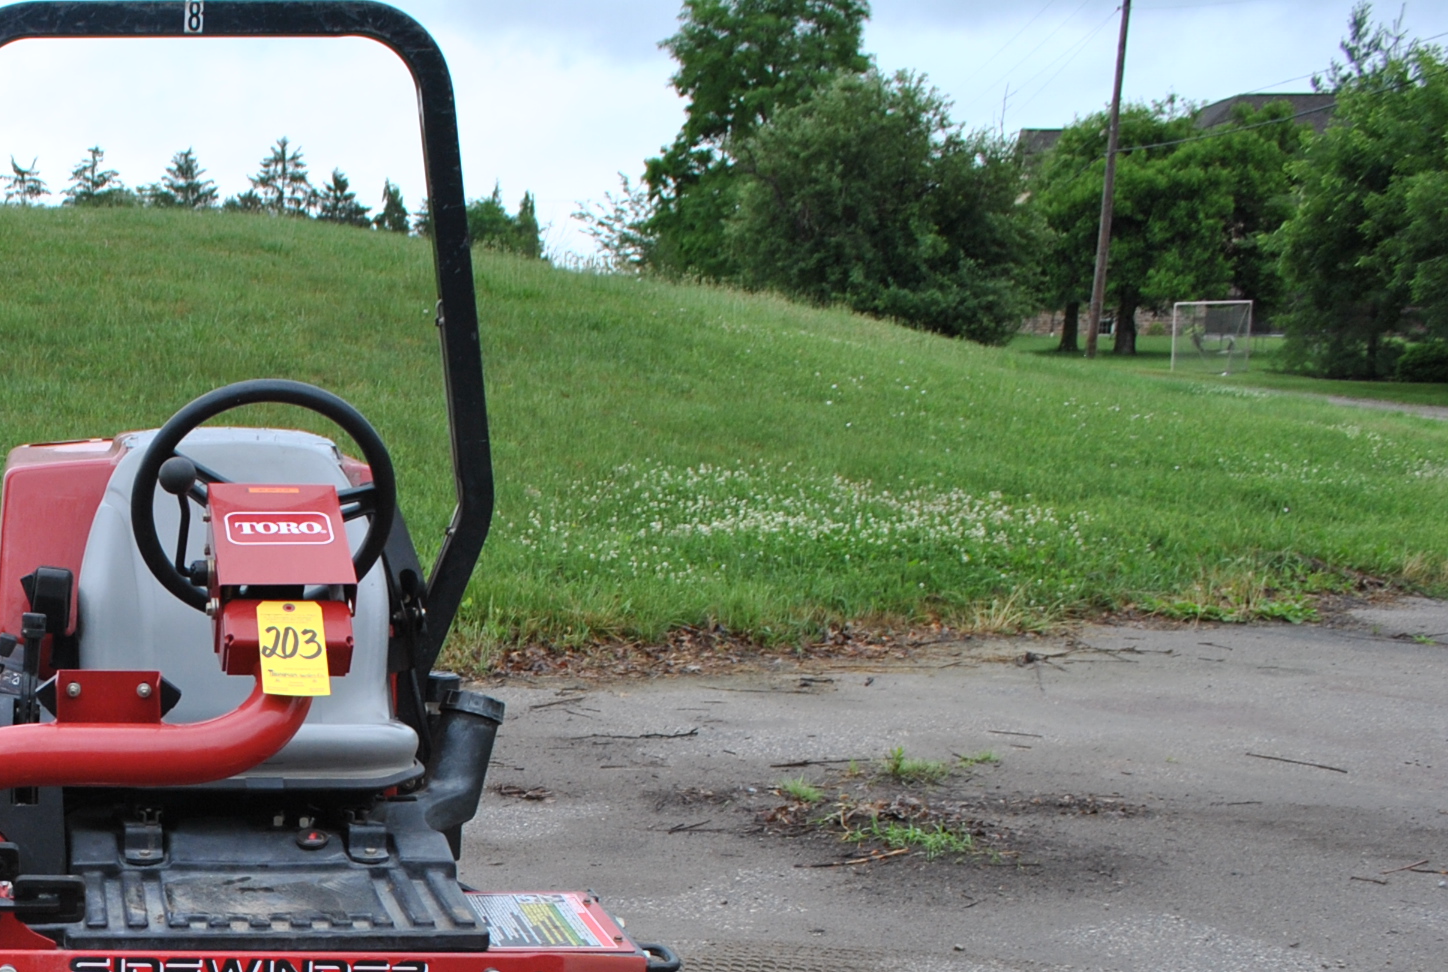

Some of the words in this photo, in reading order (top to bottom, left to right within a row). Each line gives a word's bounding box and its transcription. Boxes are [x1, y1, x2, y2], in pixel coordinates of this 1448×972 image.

[187, 1, 201, 32] 8
[235, 521, 321, 535] TORO
[261, 626, 323, 660] 203
